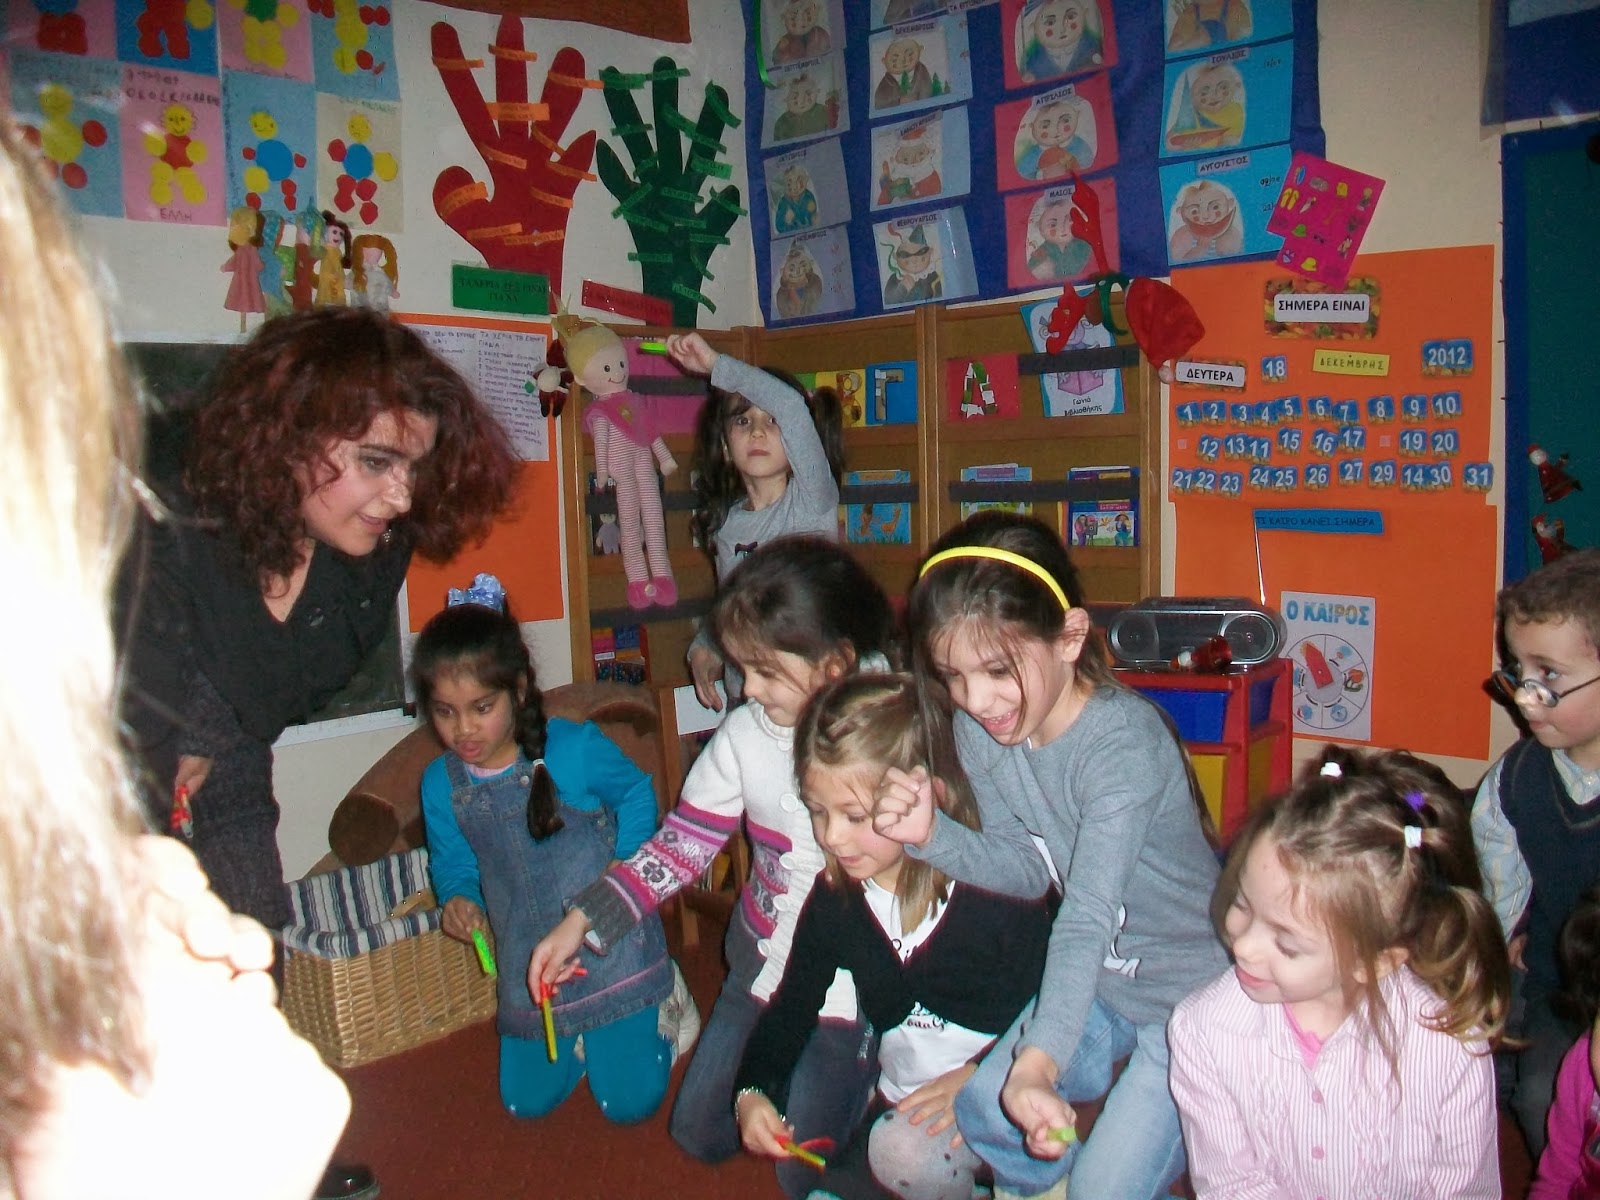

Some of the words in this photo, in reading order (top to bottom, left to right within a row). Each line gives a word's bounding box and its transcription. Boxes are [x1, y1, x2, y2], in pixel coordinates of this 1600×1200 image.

[1036, 87, 1073, 105] ΑΠΡΙΛΙΟΣ
[1200, 156, 1248, 172] ΑΥΓΟΥΣΤΟΣ
[1050, 188, 1073, 198] ΜΑΙΟΣ
[1278, 300, 1329, 311] ΣΗΜΕΡΑ
[1332, 300, 1365, 311] ΕΙΝΑΙ
[1186, 368, 1234, 381] ΔΕΥΤΕΡΑ
[1265, 360, 1285, 377] 18
[1320, 357, 1384, 371] ΔΕΚΕΜΒΡΗΣ
[1428, 346, 1466, 366] 2012
[1072, 396, 1092, 405] Γωνιά
[1183, 405, 1193, 421] 1
[1210, 403, 1219, 419] 2
[1239, 405, 1247, 421] 3
[1261, 406, 1270, 422] 4
[1284, 399, 1294, 416] 5
[1315, 399, 1325, 416] 6
[1340, 405, 1349, 422] 7
[1376, 400, 1385, 418] 8
[1410, 399, 1420, 417] 9
[1435, 396, 1456, 415] 10
[1201, 439, 1219, 458] 12
[1226, 437, 1245, 455] 13
[1249, 444, 1269, 458] 11
[1281, 431, 1300, 450] 15
[1315, 433, 1334, 453] 16
[1343, 430, 1363, 448] 17
[1402, 433, 1423, 451] 19
[1434, 433, 1454, 452] 20
[1173, 471, 1192, 489] 21
[1195, 471, 1215, 490] 22
[1221, 475, 1239, 492] 23
[1250, 468, 1269, 486] 24
[1275, 469, 1294, 487] 25
[1308, 467, 1327, 484] 26
[1344, 462, 1363, 480] 27
[1374, 464, 1394, 483] 29
[1404, 468, 1423, 485] 14
[1430, 465, 1450, 486] 30
[1466, 467, 1489, 486] 31
[1255, 516, 1266, 525] ΤΙ
[1269, 516, 1298, 526] ΚΑΙΡΟ
[1300, 517, 1331, 526] ΚΑΝΕΙ
[1334, 517, 1375, 527] ΣΗΜΕΡΑ
[1285, 600, 1298, 620] Ο
[1303, 602, 1370, 626] ΚΑΙΡΟΣ
